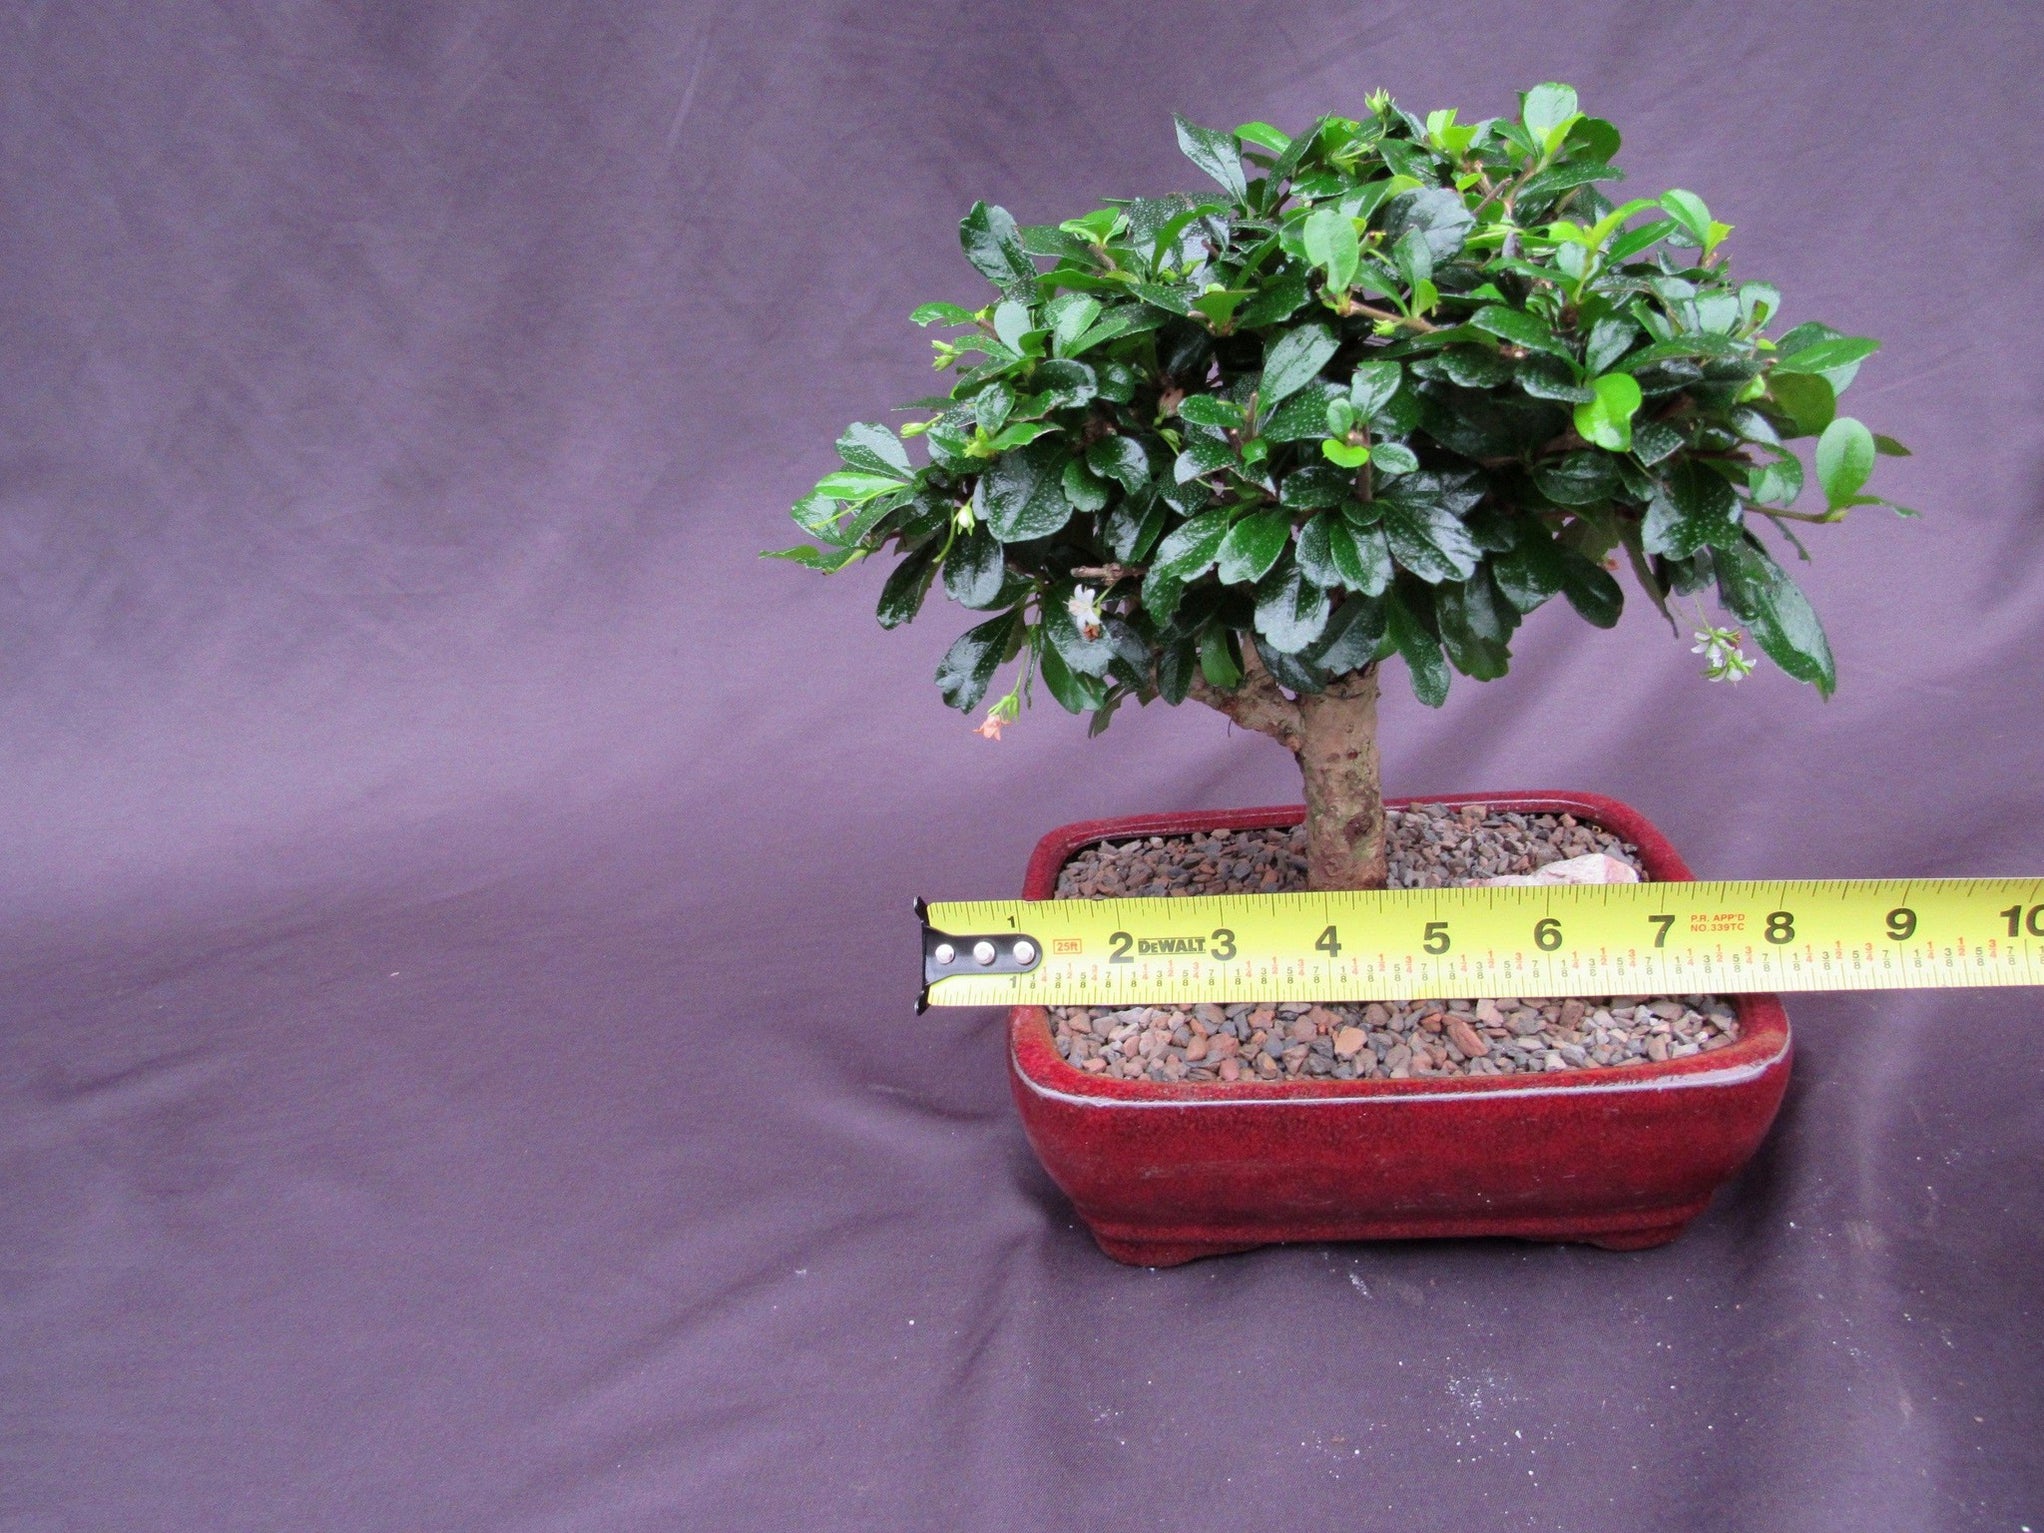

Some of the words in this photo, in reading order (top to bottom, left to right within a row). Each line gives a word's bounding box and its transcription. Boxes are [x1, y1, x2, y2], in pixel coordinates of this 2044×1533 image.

[1007, 916, 1016, 928] 1
[1423, 922, 1450, 955] 5
[1534, 918, 1562, 952] 6
[1648, 915, 1675, 948] 7
[1764, 911, 1795, 944] 8
[1886, 908, 1917, 940] 9
[1057, 942, 1078, 952] 25ft
[1108, 931, 1134, 964] 2
[1211, 928, 1237, 961] 3
[1315, 926, 1342, 958] 4
[1010, 976, 1017, 988] 1
